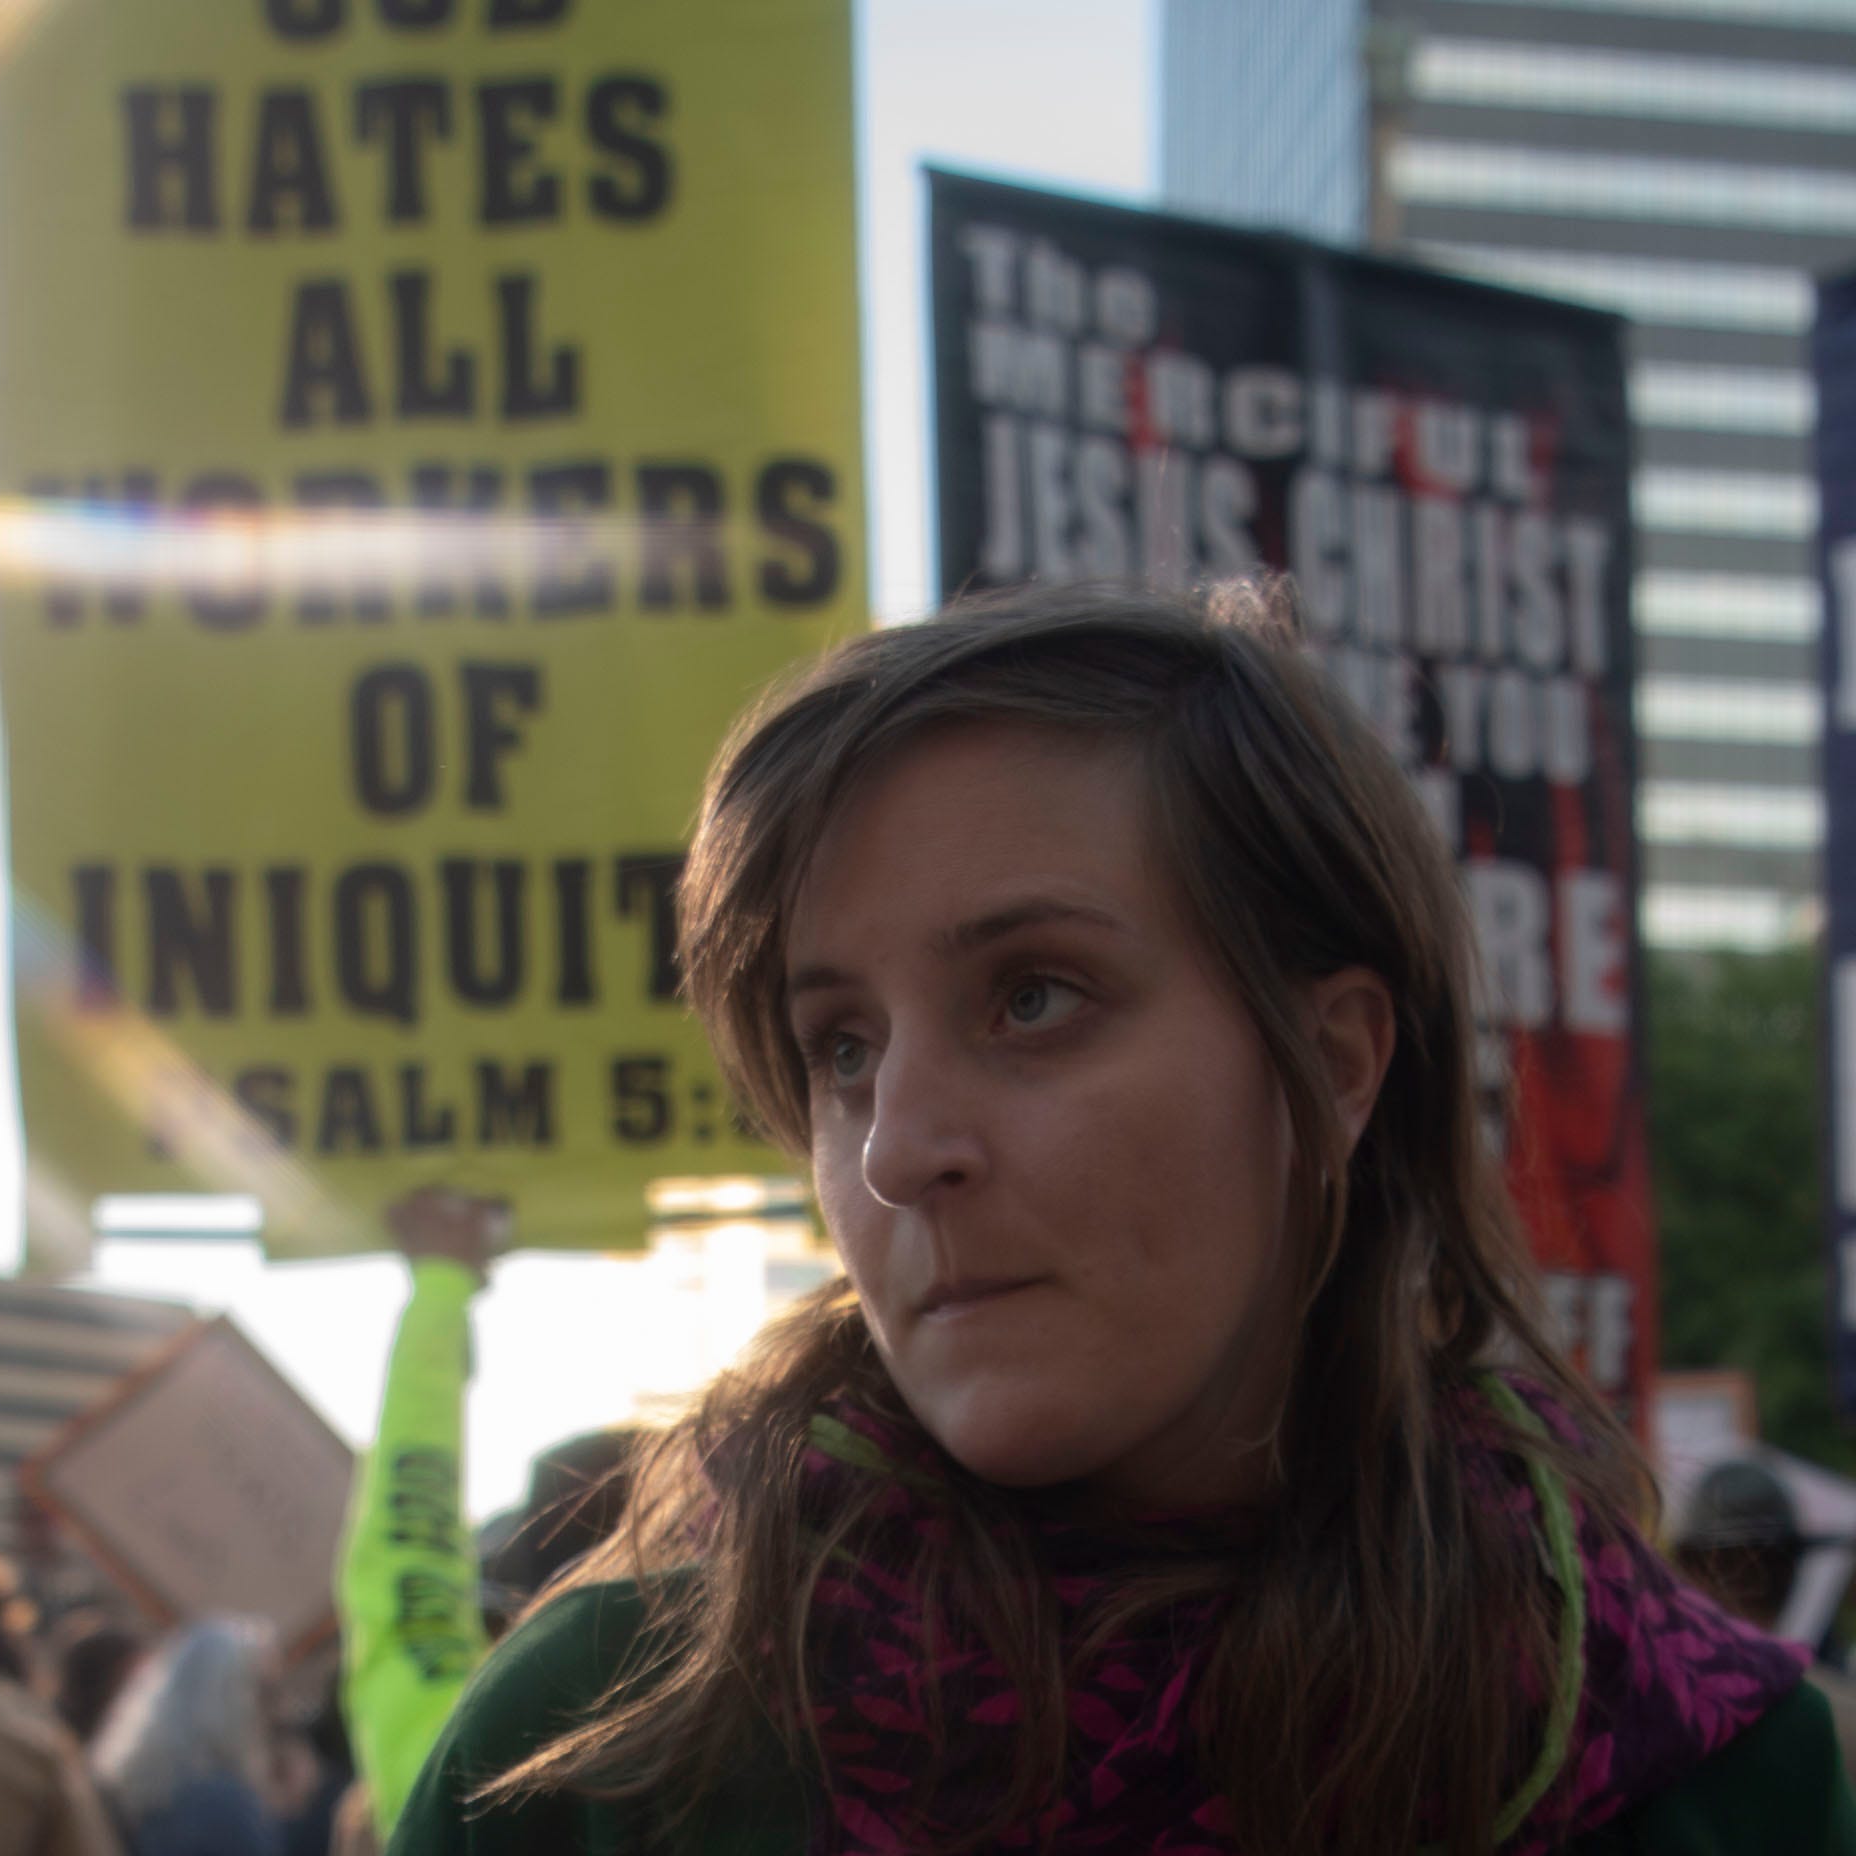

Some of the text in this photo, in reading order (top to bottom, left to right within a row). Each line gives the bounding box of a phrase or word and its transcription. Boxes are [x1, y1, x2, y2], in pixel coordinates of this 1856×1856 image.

[121, 72, 678, 237] HATES
[279, 270, 584, 431] ALL
[980, 410, 1611, 681] JESUS CHRIST
[350, 659, 544, 818] OF
[71, 853, 690, 1026] INIQUIT
[147, 1054, 770, 1154] SALM 5:
